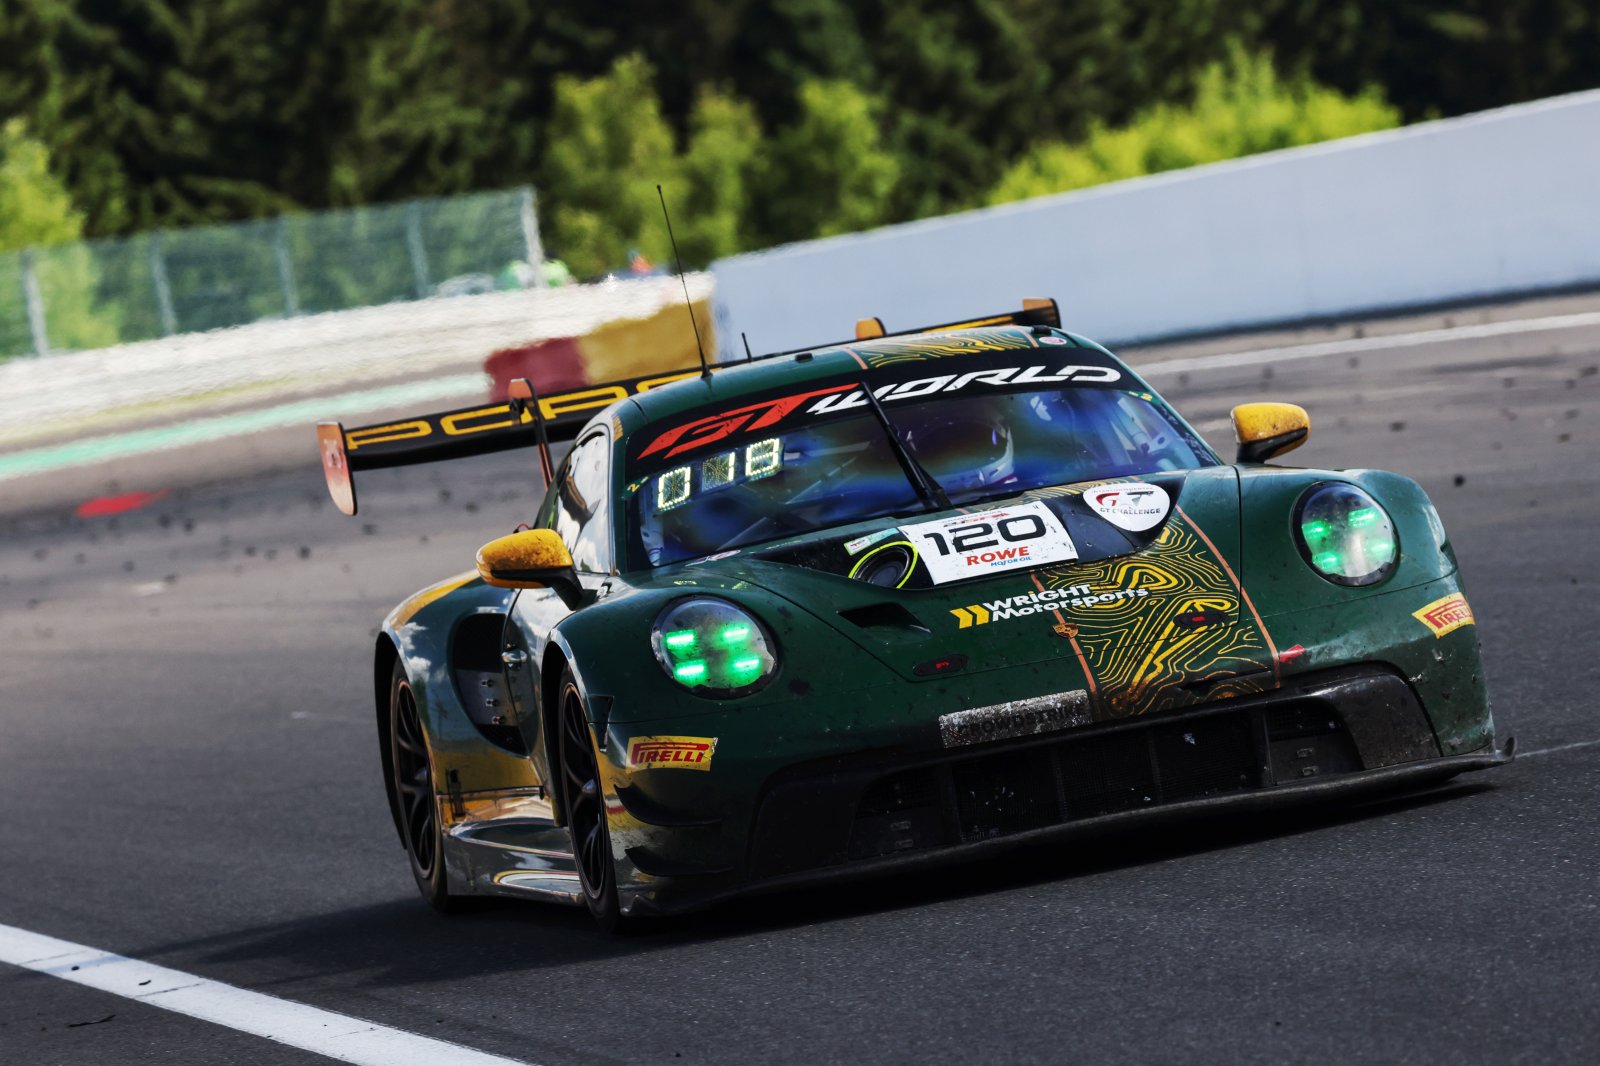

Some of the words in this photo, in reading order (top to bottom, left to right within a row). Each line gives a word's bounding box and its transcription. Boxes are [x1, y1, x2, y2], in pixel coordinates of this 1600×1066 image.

[806, 365, 1121, 416] WORLD
[1112, 507, 1161, 515] CHALLENGE
[923, 514, 1047, 556] 120
[966, 546, 1030, 566] ROWE
[992, 588, 1149, 622] Motorsports
[631, 742, 709, 765] PIRELLI
